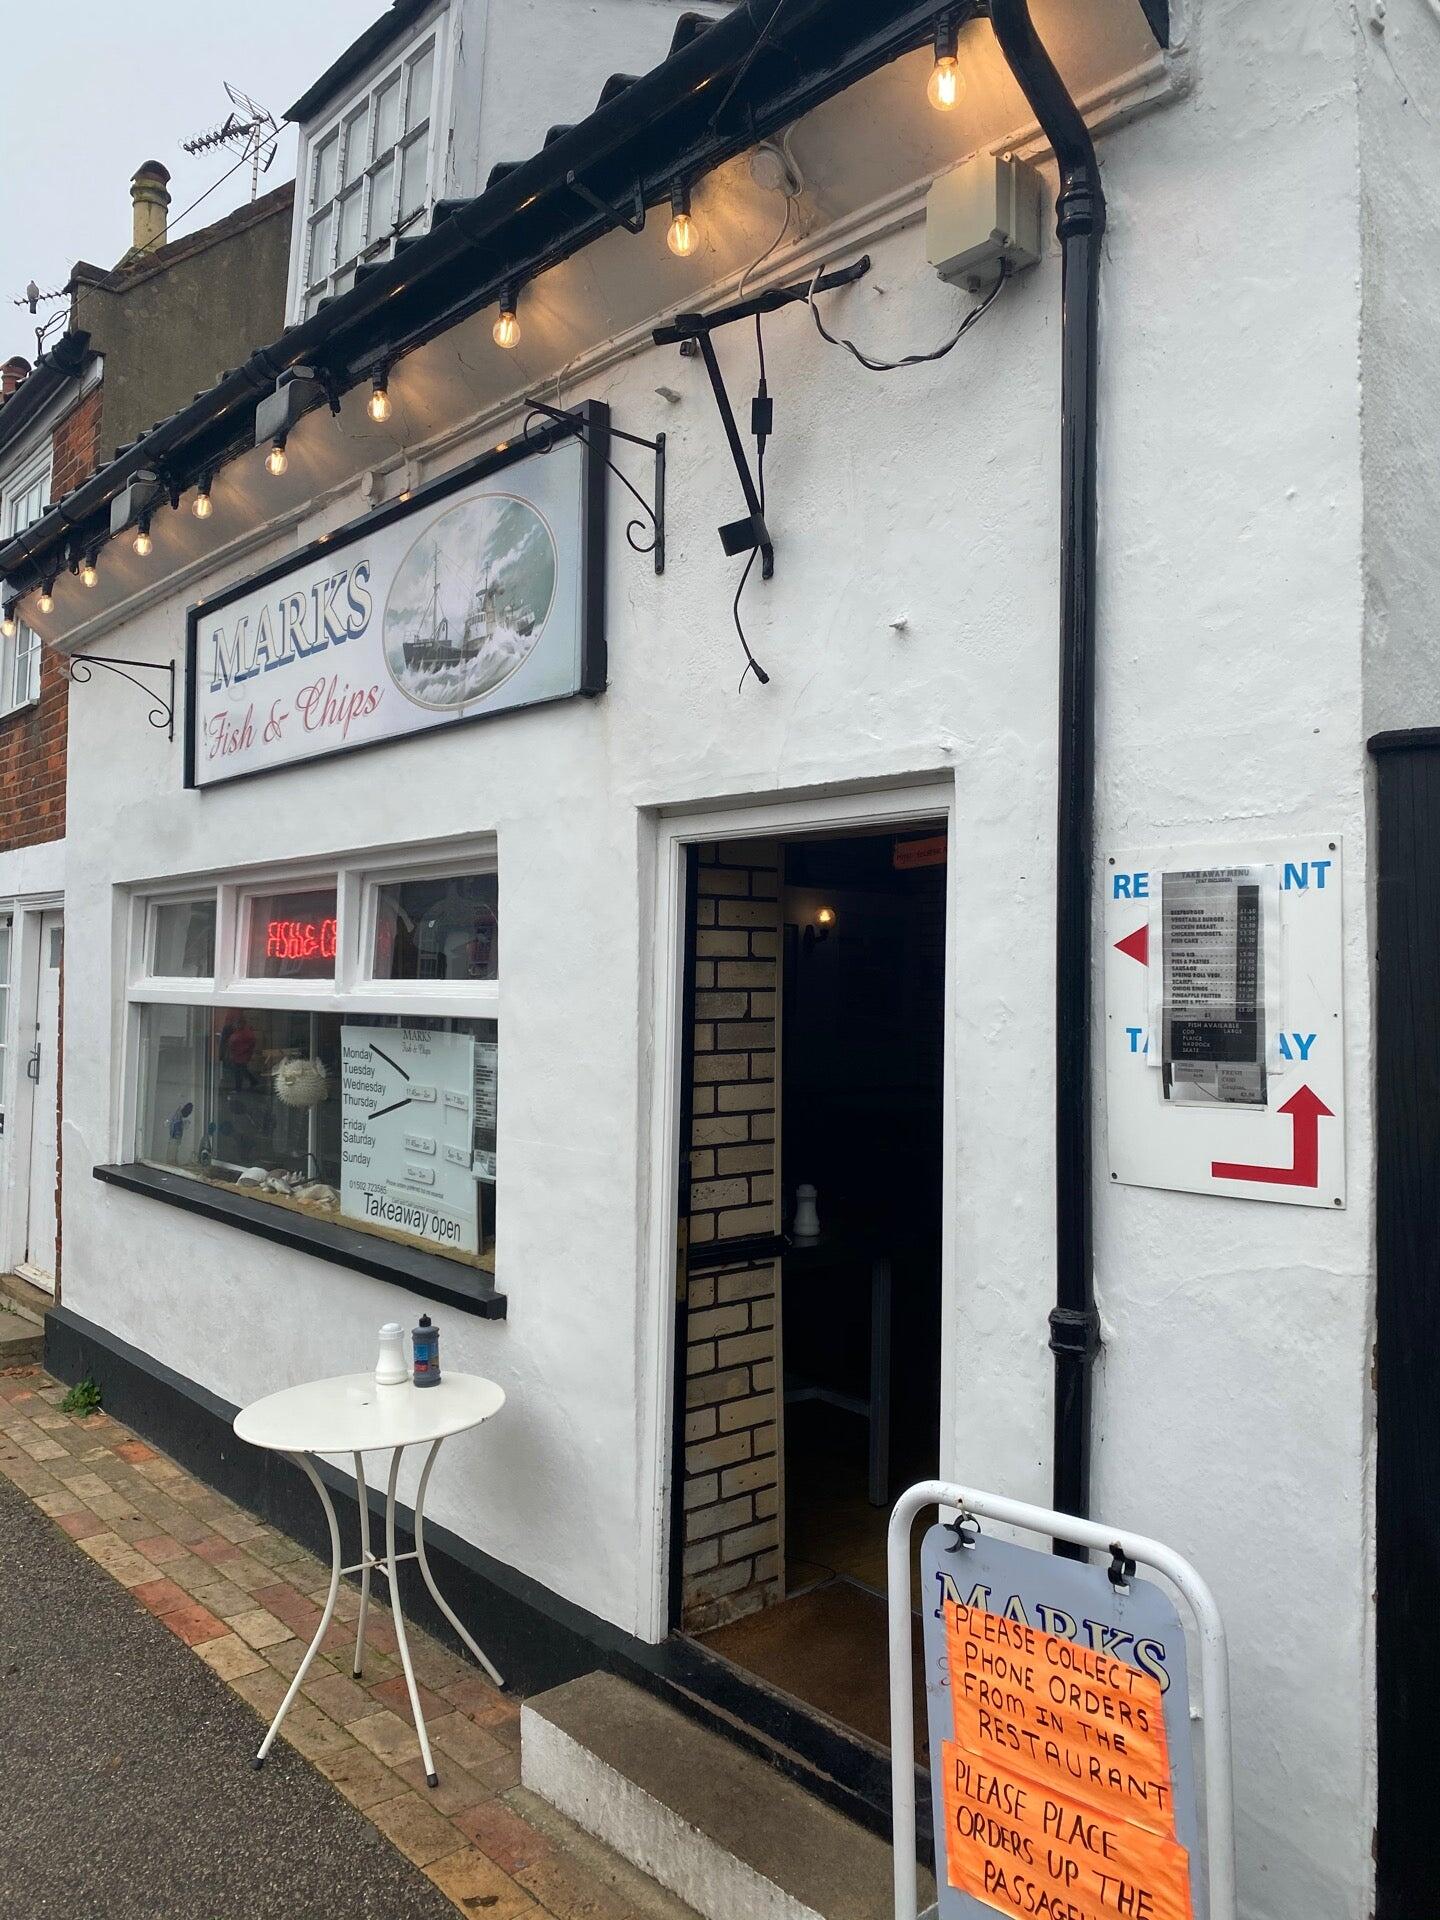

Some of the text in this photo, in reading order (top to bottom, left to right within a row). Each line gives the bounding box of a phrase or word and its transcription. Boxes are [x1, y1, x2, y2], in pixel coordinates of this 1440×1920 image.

[210, 560, 373, 693] MARKS
[206, 673, 385, 759] Fish & Chips
[1203, 870, 1226, 878] AWAY
[403, 1029, 431, 1042] MARKS
[343, 1047, 373, 1062] Monday
[343, 1062, 375, 1078] Tuesday
[343, 1078, 386, 1096] Wednesday
[343, 1093, 378, 1110] Thursday
[343, 1119, 366, 1134] Friday
[343, 1132, 376, 1148] Saturday
[343, 1151, 371, 1167] Sunday
[349, 1180, 366, 1191] 01502
[364, 1192, 428, 1235] Takeaway
[431, 1215, 461, 1242] open
[956, 1605, 1143, 1694] PLEASE COLLECT
[964, 1642, 1035, 1693] PHONE
[1049, 1675, 1149, 1733] ORDERS
[1036, 1705, 1064, 1733] IN
[1078, 1721, 1129, 1755] THE
[978, 1709, 1169, 1811] RESTAURANT
[956, 1759, 1119, 1862] PLEASE PLACE
[956, 1806, 1154, 1920] ORDERS UP THE
